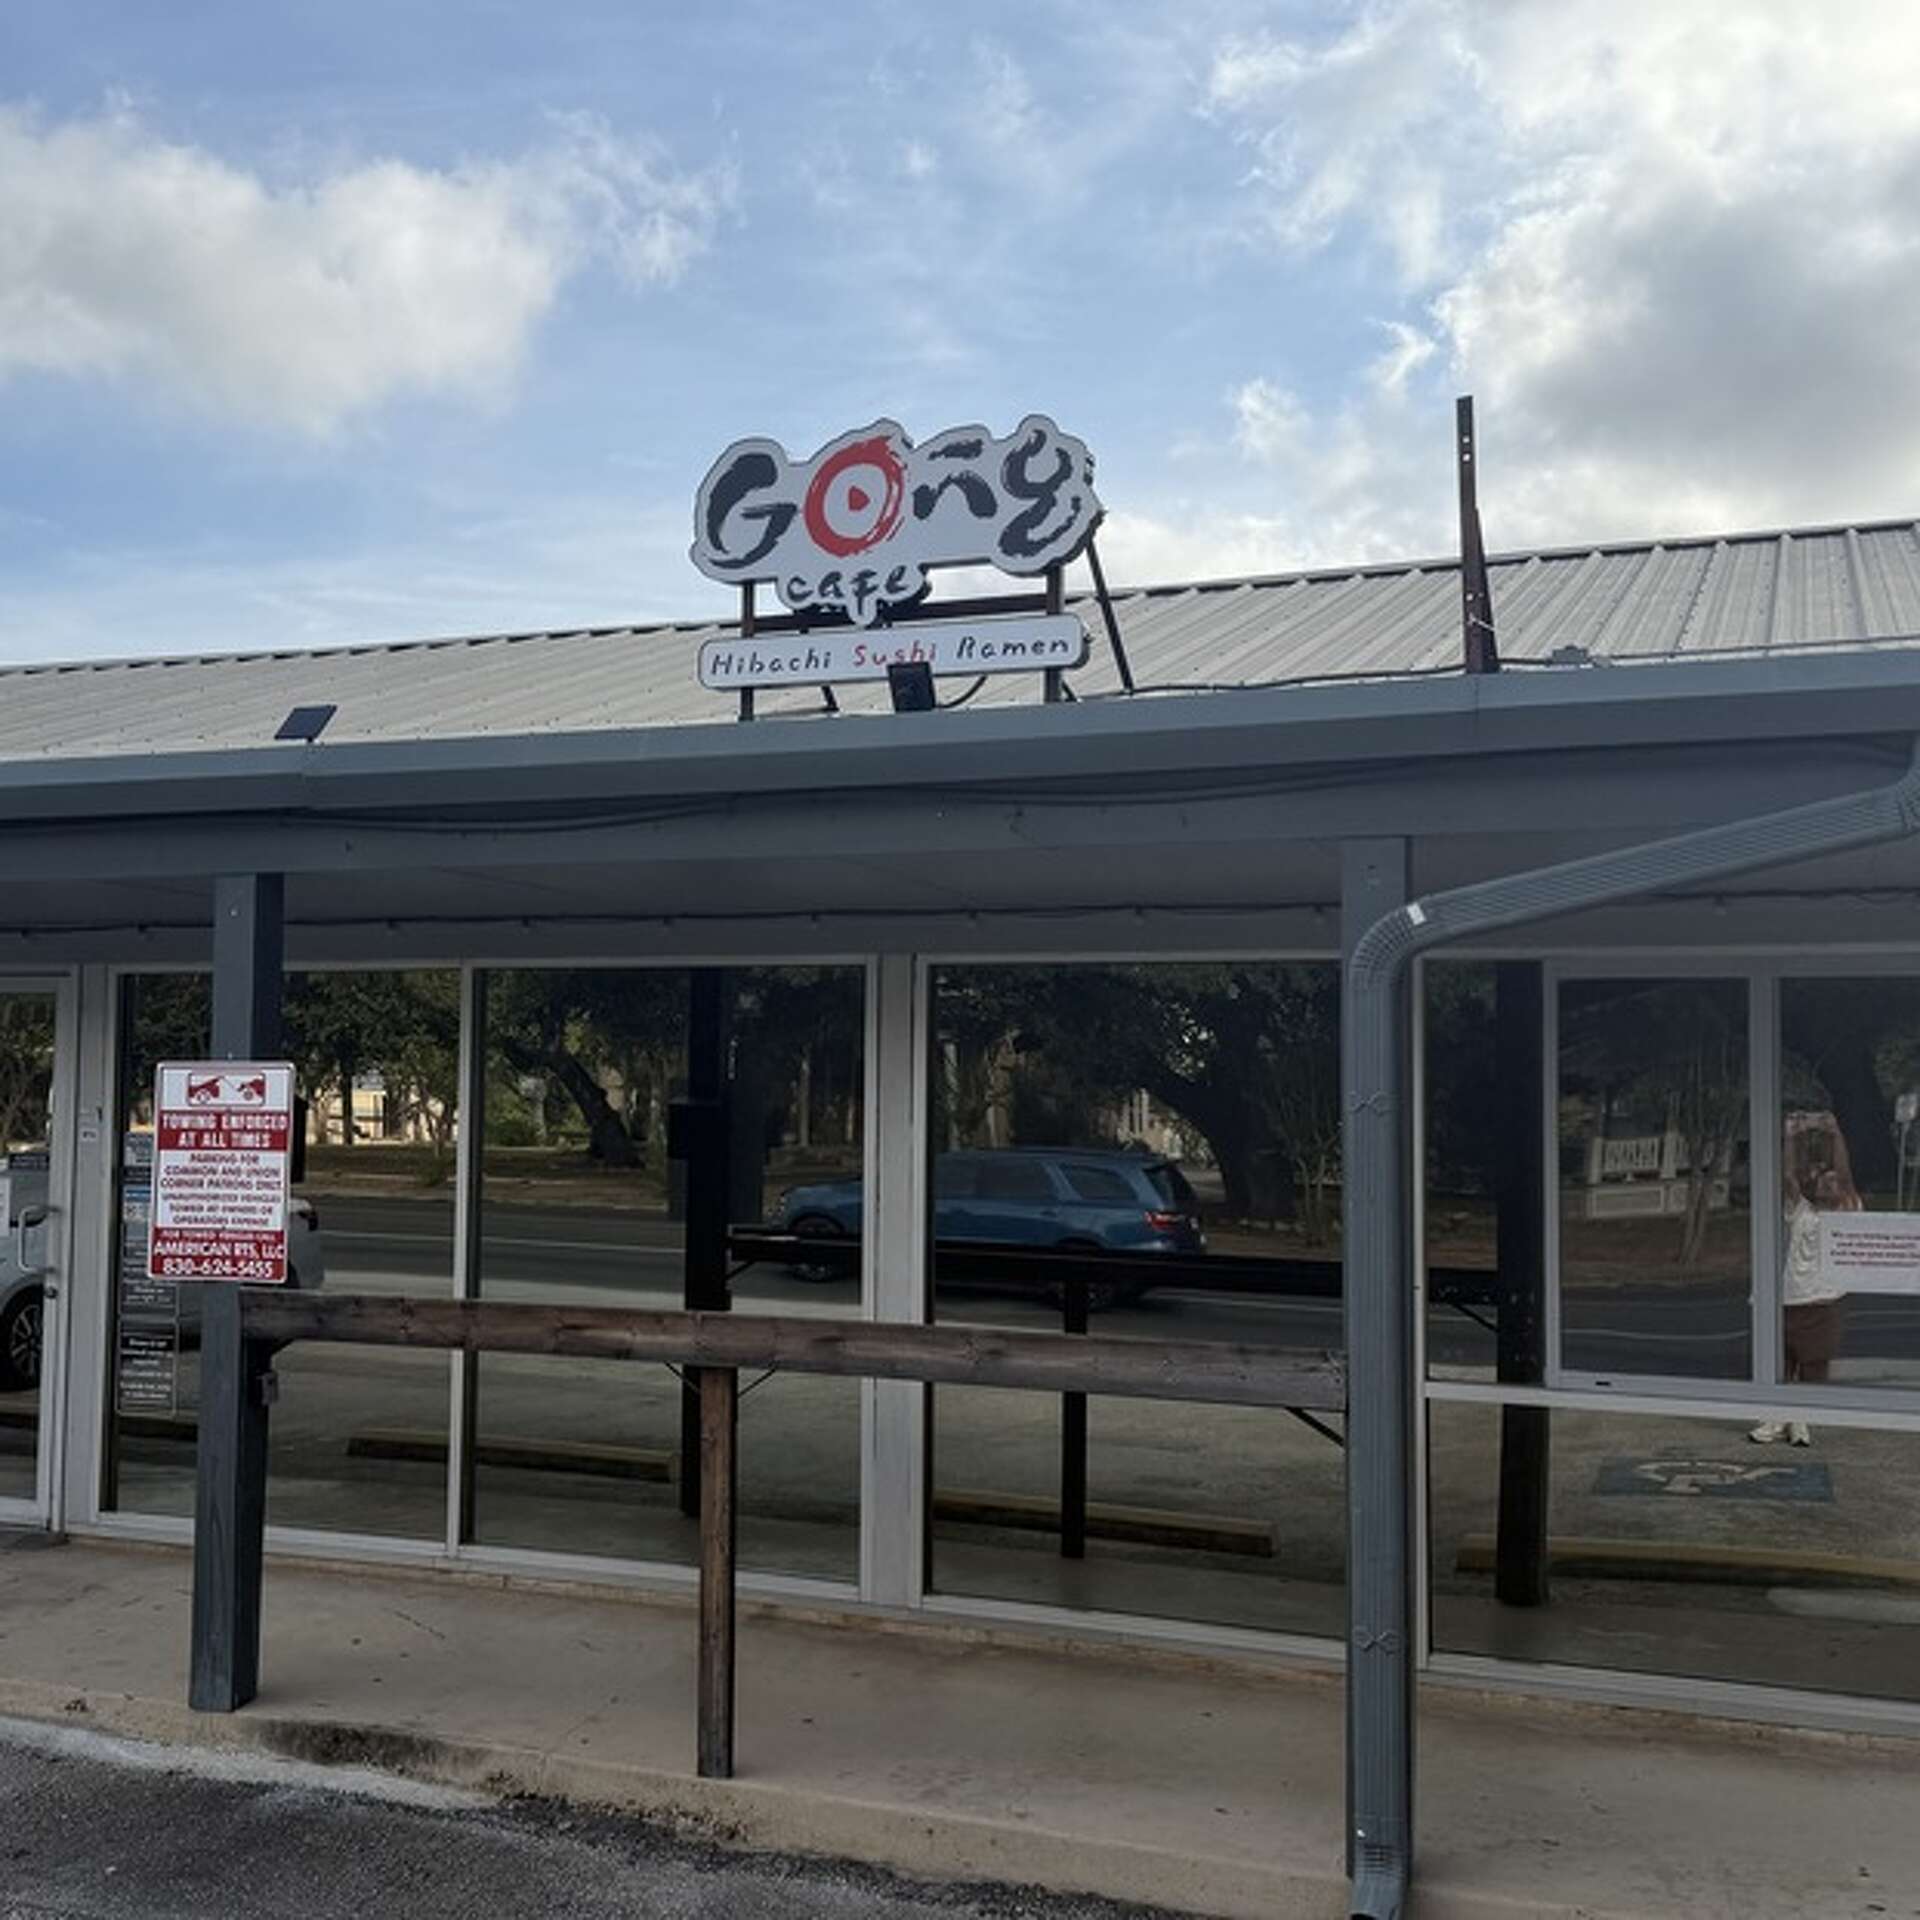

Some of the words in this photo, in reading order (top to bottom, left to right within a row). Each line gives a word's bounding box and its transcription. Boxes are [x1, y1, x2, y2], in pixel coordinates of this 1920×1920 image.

[711, 652, 832, 676] Hibachi
[852, 641, 937, 667] Sushi
[957, 635, 1069, 661] Ramen
[162, 1114, 217, 1130] TOWING
[221, 1115, 288, 1131] ENFORCED
[178, 1131, 197, 1147] AT
[202, 1132, 227, 1148] ALL
[231, 1132, 271, 1148] TIMES
[190, 1153, 238, 1164] PARKING
[240, 1154, 260, 1165] FOR
[164, 1165, 218, 1177] COMMON
[221, 1166, 241, 1177] AND
[153, 1241, 232, 1257] AMERICAN
[261, 1243, 285, 1259] LLC
[162, 1257, 274, 1279] 830-624-5455
